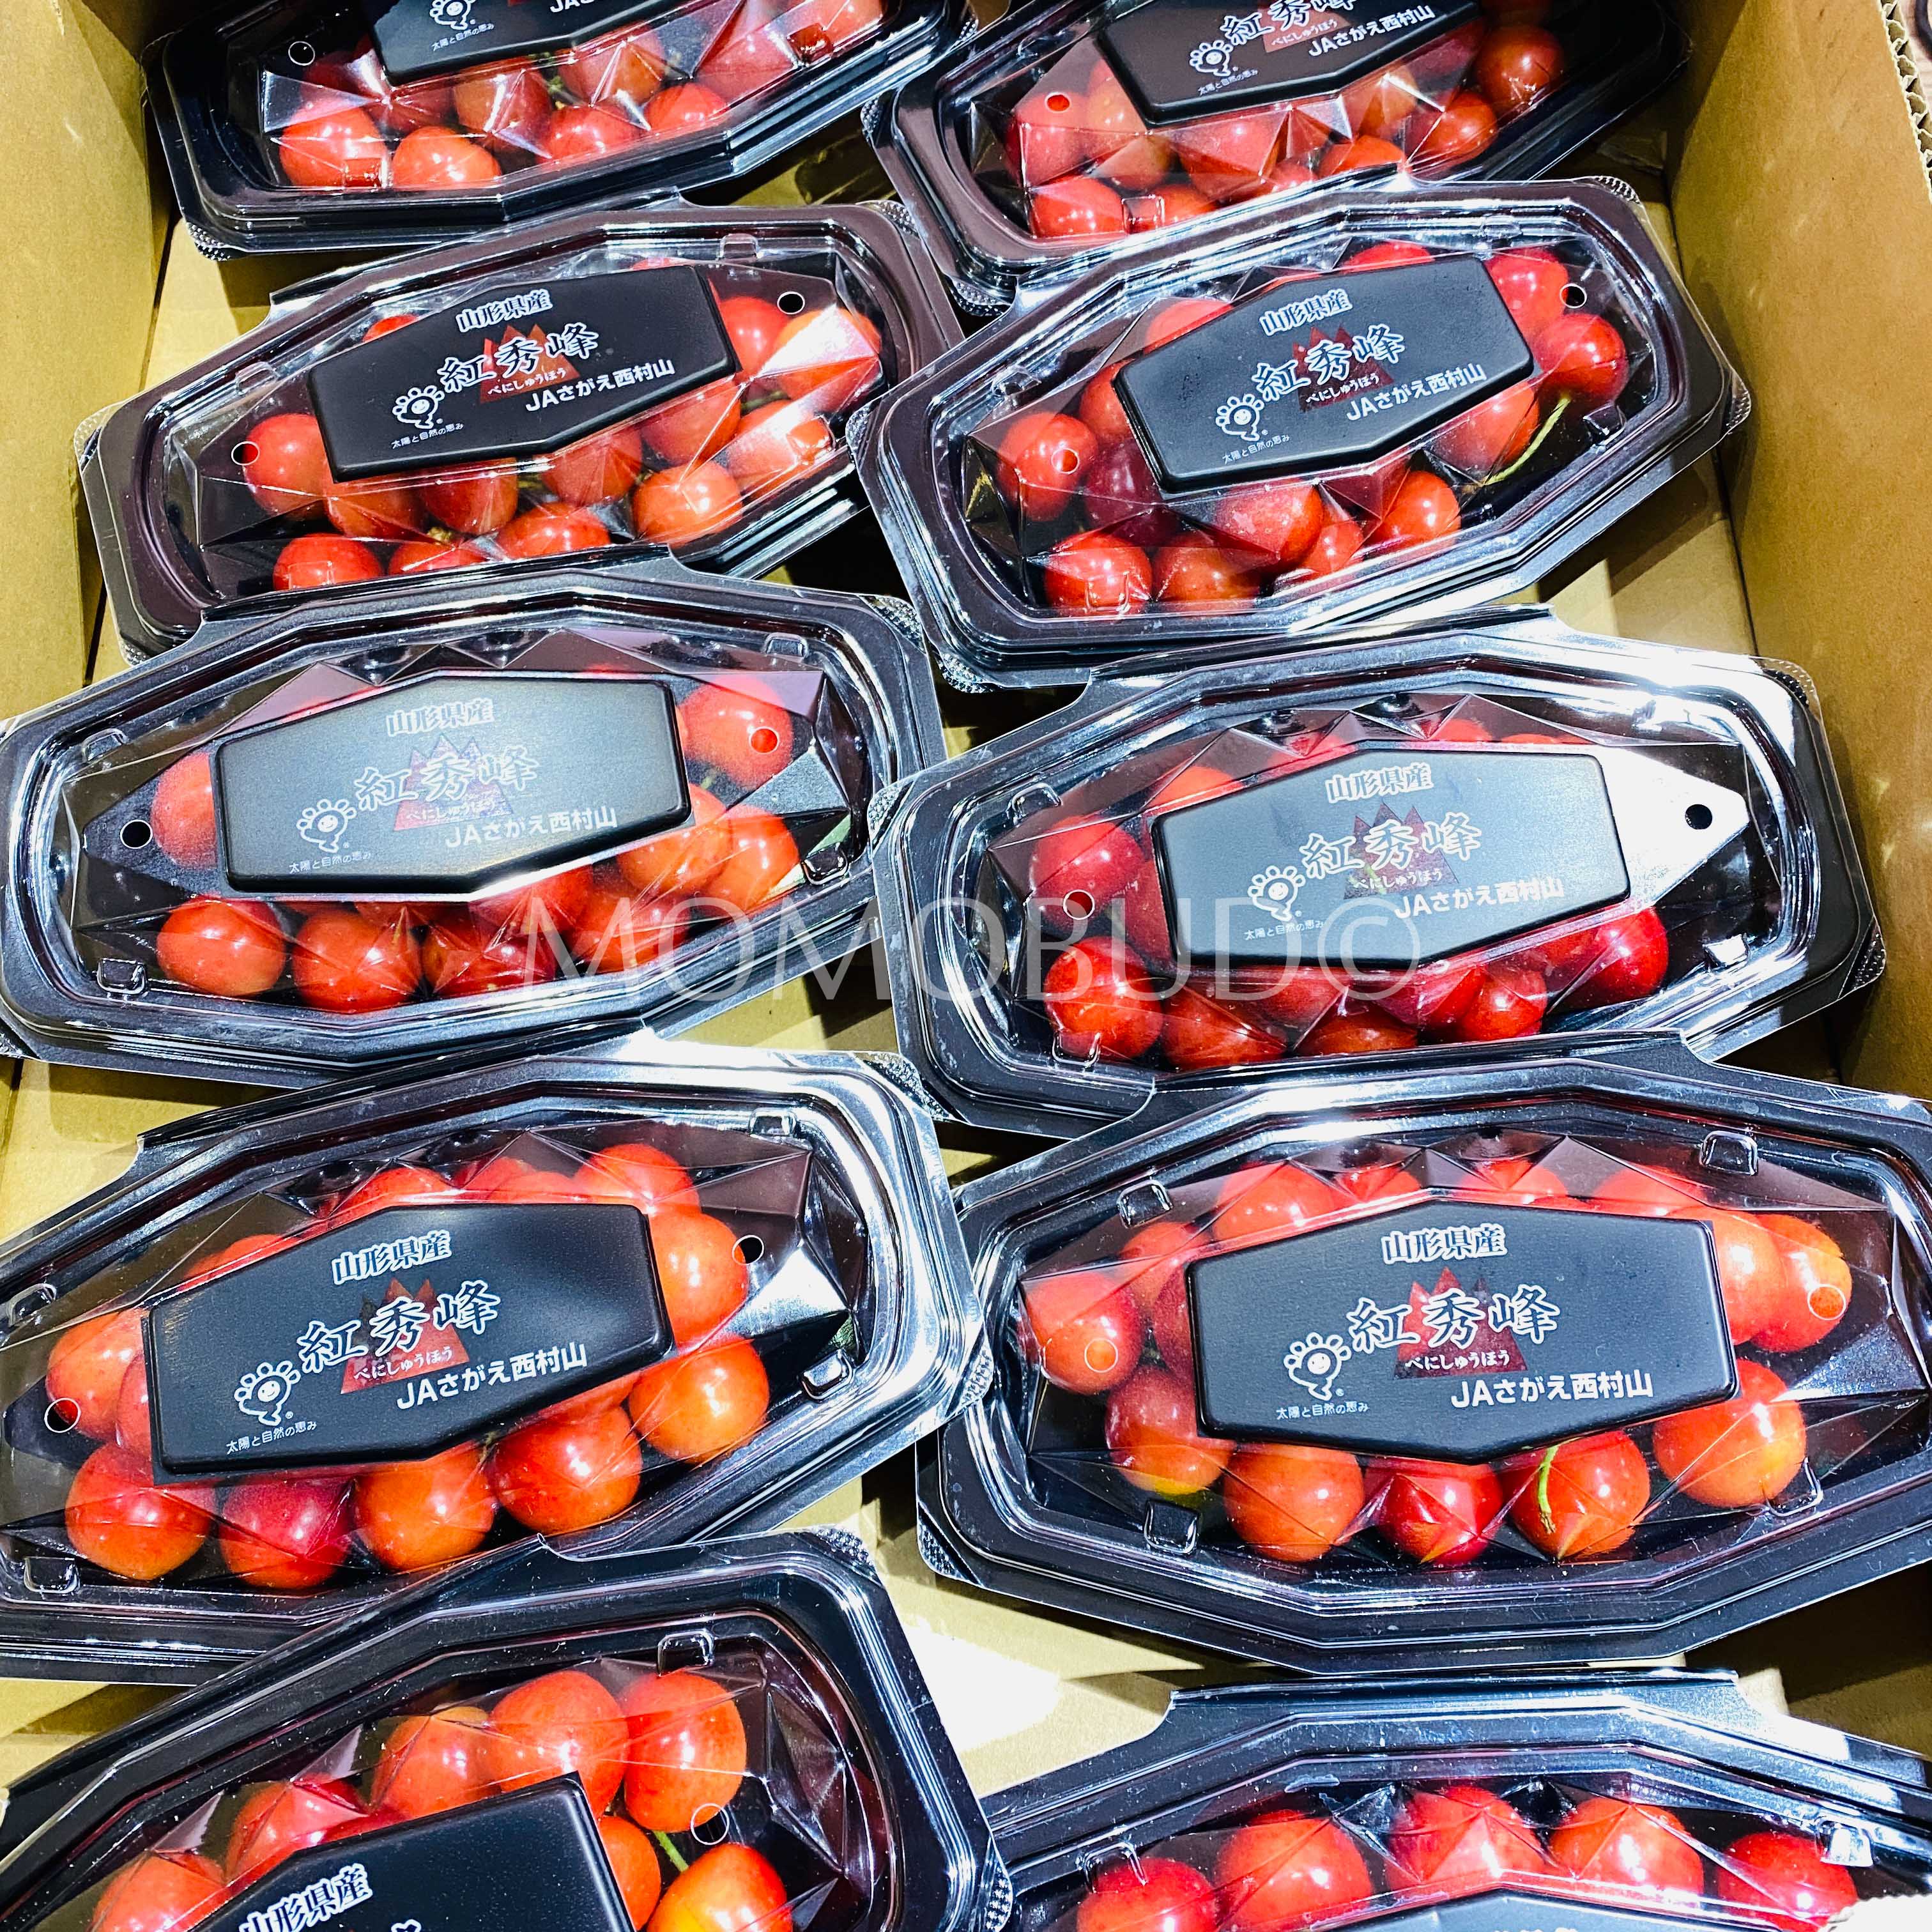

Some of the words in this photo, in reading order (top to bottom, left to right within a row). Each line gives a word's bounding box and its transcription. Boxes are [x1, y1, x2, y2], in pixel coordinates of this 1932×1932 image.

[1308, 4, 1436, 57] JAさがえ西村山
[455, 288, 553, 333] 山形県産
[1259, 288, 1353, 337] 山形県産
[437, 321, 599, 394] 紅秀峰
[1251, 323, 1406, 402] 紅秀峰
[487, 367, 567, 395] べにしゅうほう
[525, 358, 677, 412] JAさがえ西村山
[1305, 372, 1380, 403] べにしゅうほう
[1346, 363, 1487, 422] JAさがえ西村山
[385, 697, 495, 737] 山形県産
[353, 744, 540, 813] 紅秀峰
[1324, 762, 1434, 804] 山形県産
[447, 806, 618, 848] JAさがえ西村山
[1298, 811, 1482, 880] 紅秀峰
[1394, 876, 1565, 919] JAさがえ西村山
[331, 1229, 452, 1286] 山形県産
[1381, 1222, 1508, 1266] 山形県産
[296, 1279, 502, 1374] 紅秀峰
[1347, 1283, 1561, 1355] 紅秀峰
[353, 1346, 453, 1379] べにしゅうほう
[396, 1342, 588, 1411] JAさがえ西村山
[1404, 1349, 1510, 1370] べにしゅうほう
[1275, 1400, 1369, 1420] 太陽と自然の恵み
[1450, 1368, 1654, 1409] JAさがえ西村山
[226, 1420, 318, 1455] 太陽と自然の恵み
